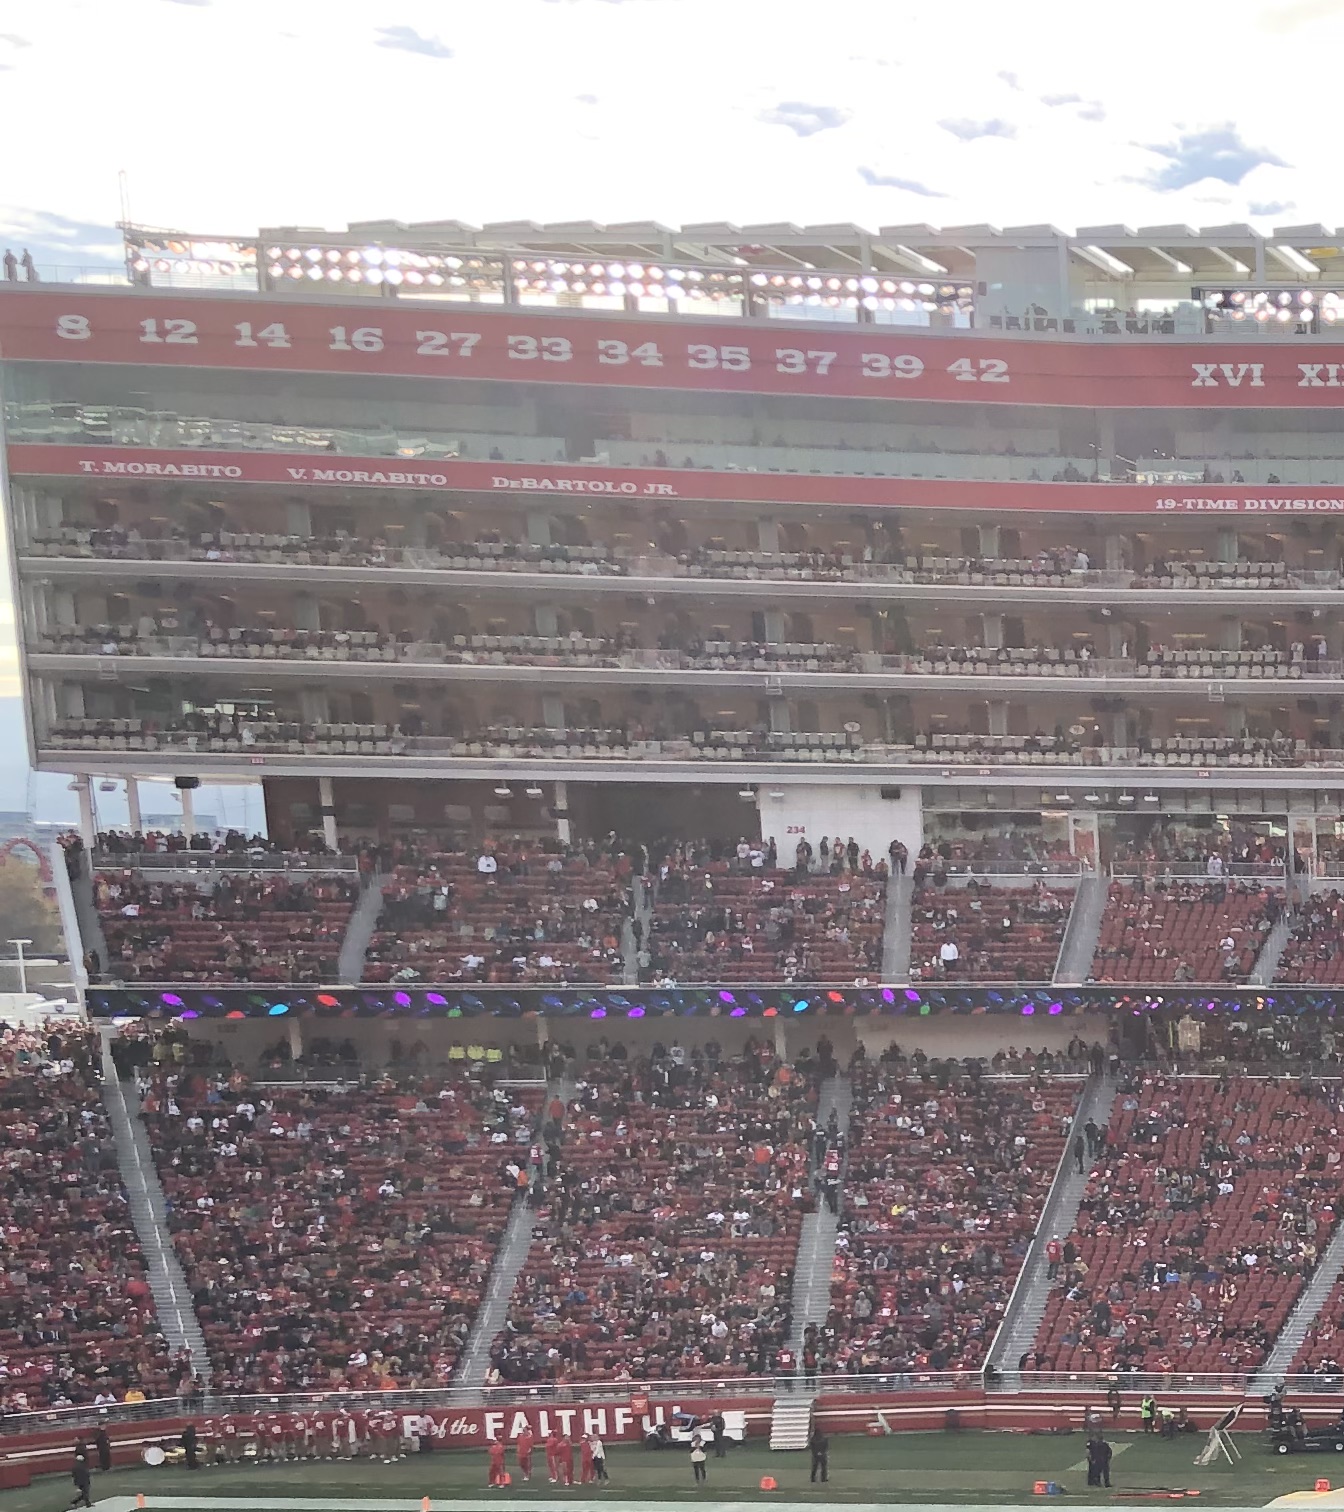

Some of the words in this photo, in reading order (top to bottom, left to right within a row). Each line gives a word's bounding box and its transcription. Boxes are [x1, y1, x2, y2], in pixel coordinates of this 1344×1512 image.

[56, 314, 91, 340] 8
[139, 318, 199, 345] 12
[234, 321, 292, 348] 14
[329, 325, 384, 352] 16
[415, 330, 482, 357] 27
[507, 335, 573, 362] 33
[597, 339, 664, 367] 34
[687, 344, 751, 371] 35
[775, 348, 838, 375] 37
[861, 353, 925, 379] 39
[946, 357, 1010, 383] 42
[1191, 363, 1265, 387] XVI
[78, 460, 99, 472] T.
[104, 461, 243, 479] MORABITO
[287, 468, 307, 480] V.
[312, 468, 449, 486] MORABITO
[643, 482, 679, 496] JR.
[1155, 498, 1239, 511] 19-TIME
[786, 825, 806, 834] 234
[450, 1416, 480, 1435] the
